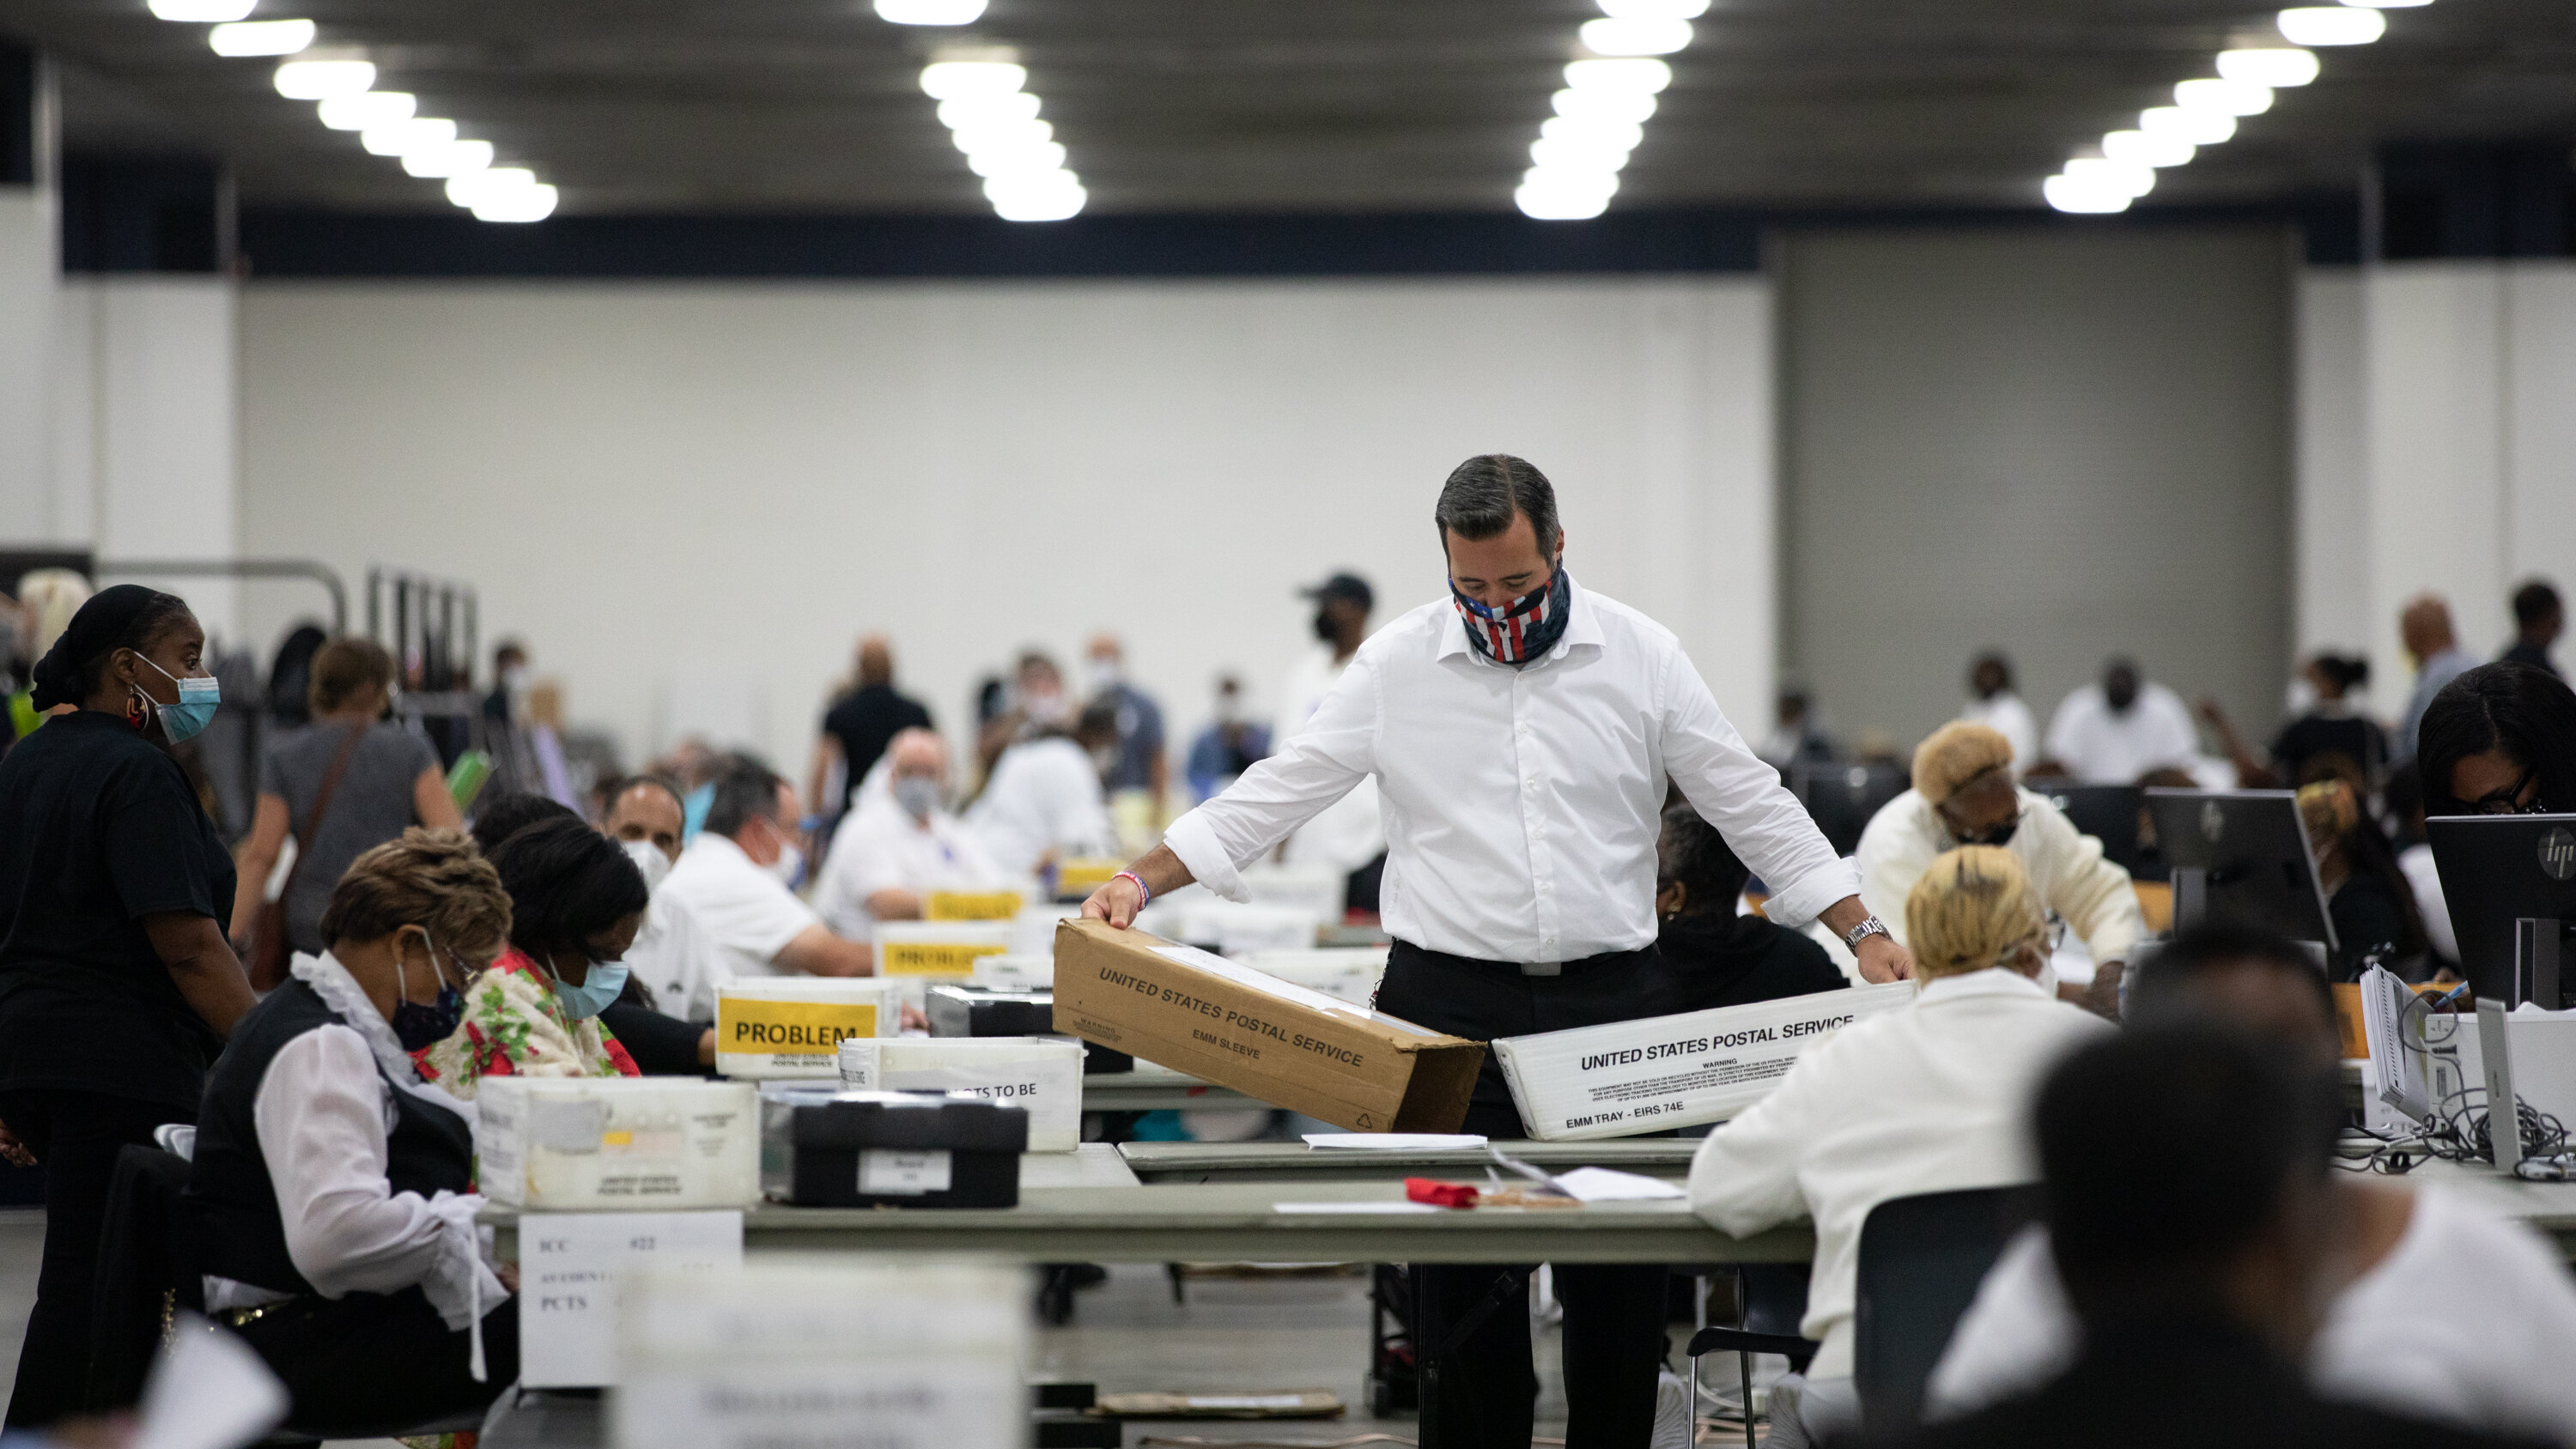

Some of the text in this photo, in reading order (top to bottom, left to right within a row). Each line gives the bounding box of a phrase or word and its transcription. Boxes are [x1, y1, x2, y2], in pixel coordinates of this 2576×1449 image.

[2547, 831, 2574, 878] hp
[1099, 967, 1364, 1068] UNITED STATES POSTAL SERVICE
[735, 1022, 858, 1046] PROBLEM
[1193, 1029, 1261, 1060] EMM SLEEVE
[1581, 1048, 1643, 1070] UNITED
[1646, 1038, 1708, 1060] STATES
[1713, 1028, 1778, 1050] POSTAL
[1702, 1058, 1737, 1070] WARNING
[1719, 1064, 1744, 1072] PERMISSION
[994, 1086, 1014, 1098] TO
[1019, 1083, 1037, 1096] BE
[1604, 1091, 1631, 1100] ELECTRONIC
[1652, 1083, 1680, 1092] TECHNOLOGY
[1657, 1087, 1688, 1095] IMPRISONMENT
[1565, 1116, 1593, 1129] EMM
[1595, 1111, 1625, 1124] TRAY
[1634, 1105, 1662, 1118] EIRS
[1663, 1100, 1685, 1113] 74E
